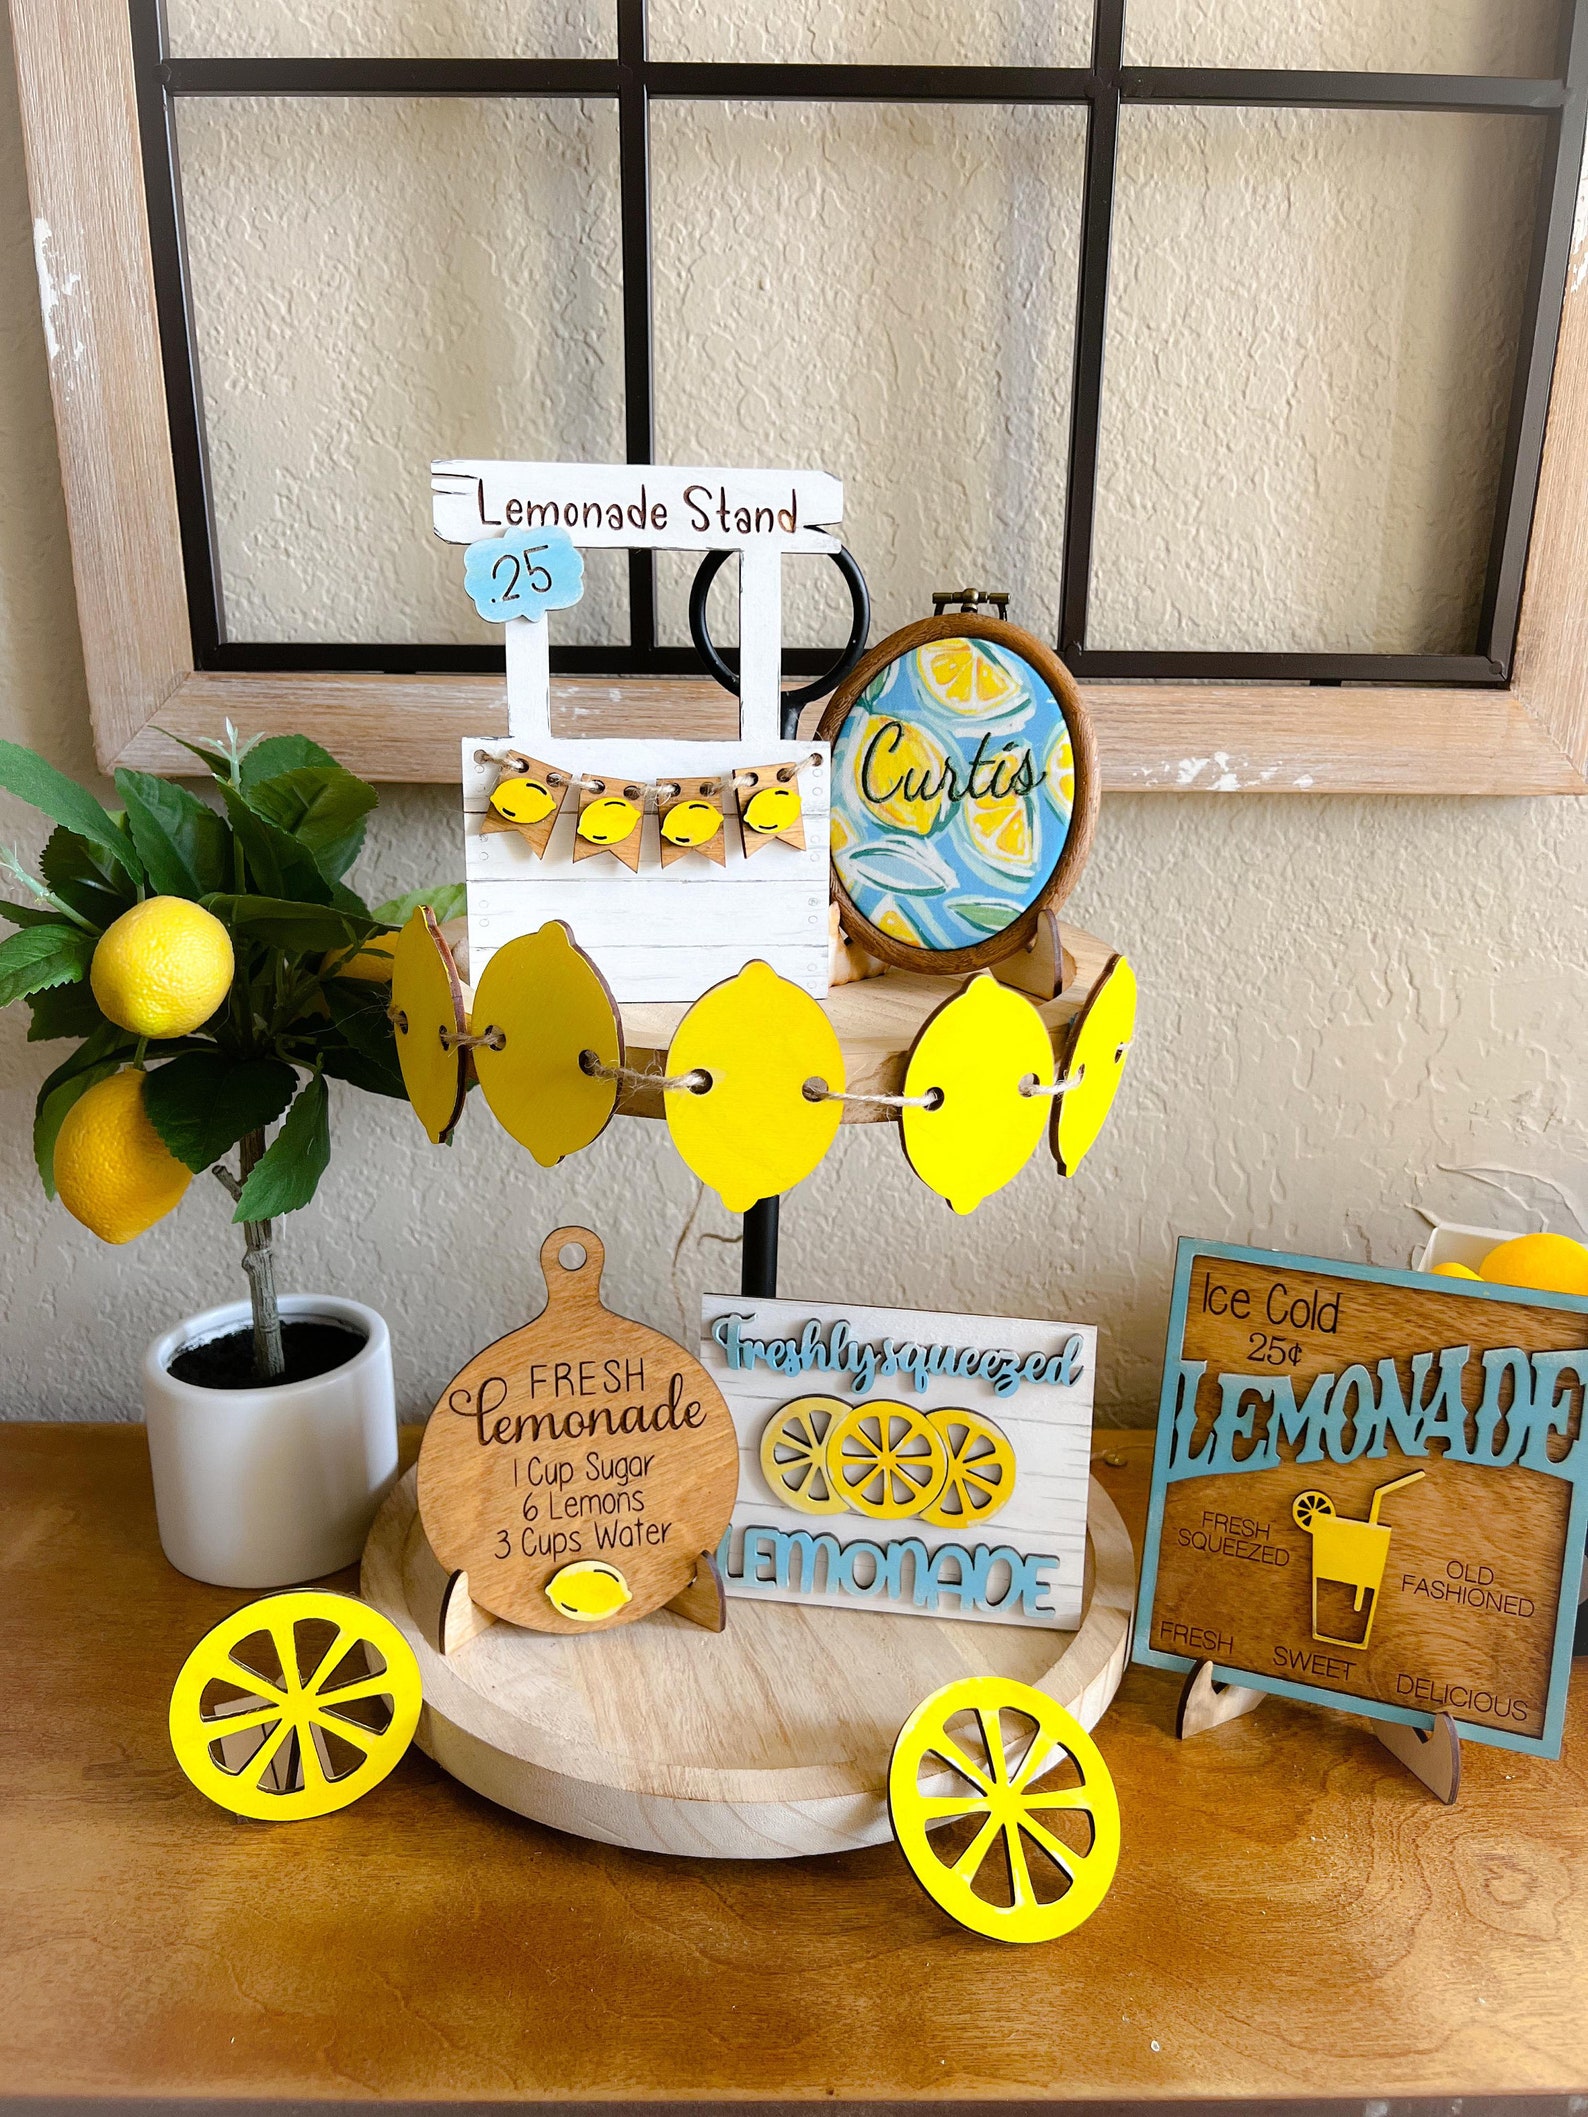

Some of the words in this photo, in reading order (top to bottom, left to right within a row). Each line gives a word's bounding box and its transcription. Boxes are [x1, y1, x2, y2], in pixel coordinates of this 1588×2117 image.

[477, 478, 668, 531] Lemonade
[682, 484, 799, 534] Stand
[489, 544, 553, 604] .25
[861, 720, 1048, 804] Curtis
[1202, 1271, 1251, 1320] Ice
[1265, 1282, 1343, 1335] Cold
[1246, 1332, 1303, 1367] 25¢
[530, 1357, 646, 1399] FRESH
[1168, 1345, 1588, 1480] LEMONADE
[512, 1458, 519, 1488] 1
[527, 1456, 575, 1491] Cup
[585, 1452, 656, 1487] Sugar
[522, 1492, 539, 1522] 6
[549, 1488, 646, 1520] Lemons
[1201, 1510, 1271, 1542] FRESH
[494, 1530, 512, 1560] 3
[521, 1526, 582, 1562] Cups
[594, 1518, 673, 1550] Water
[1177, 1527, 1291, 1568] SQUEEZED
[716, 1523, 1061, 1619] LEMONADE
[1445, 1559, 1495, 1587] OLD
[1400, 1574, 1536, 1619] FASHIONED
[1159, 1620, 1235, 1655] FRESH
[1272, 1645, 1357, 1682] SWEET
[1396, 1673, 1529, 1722] DELICIOUS
